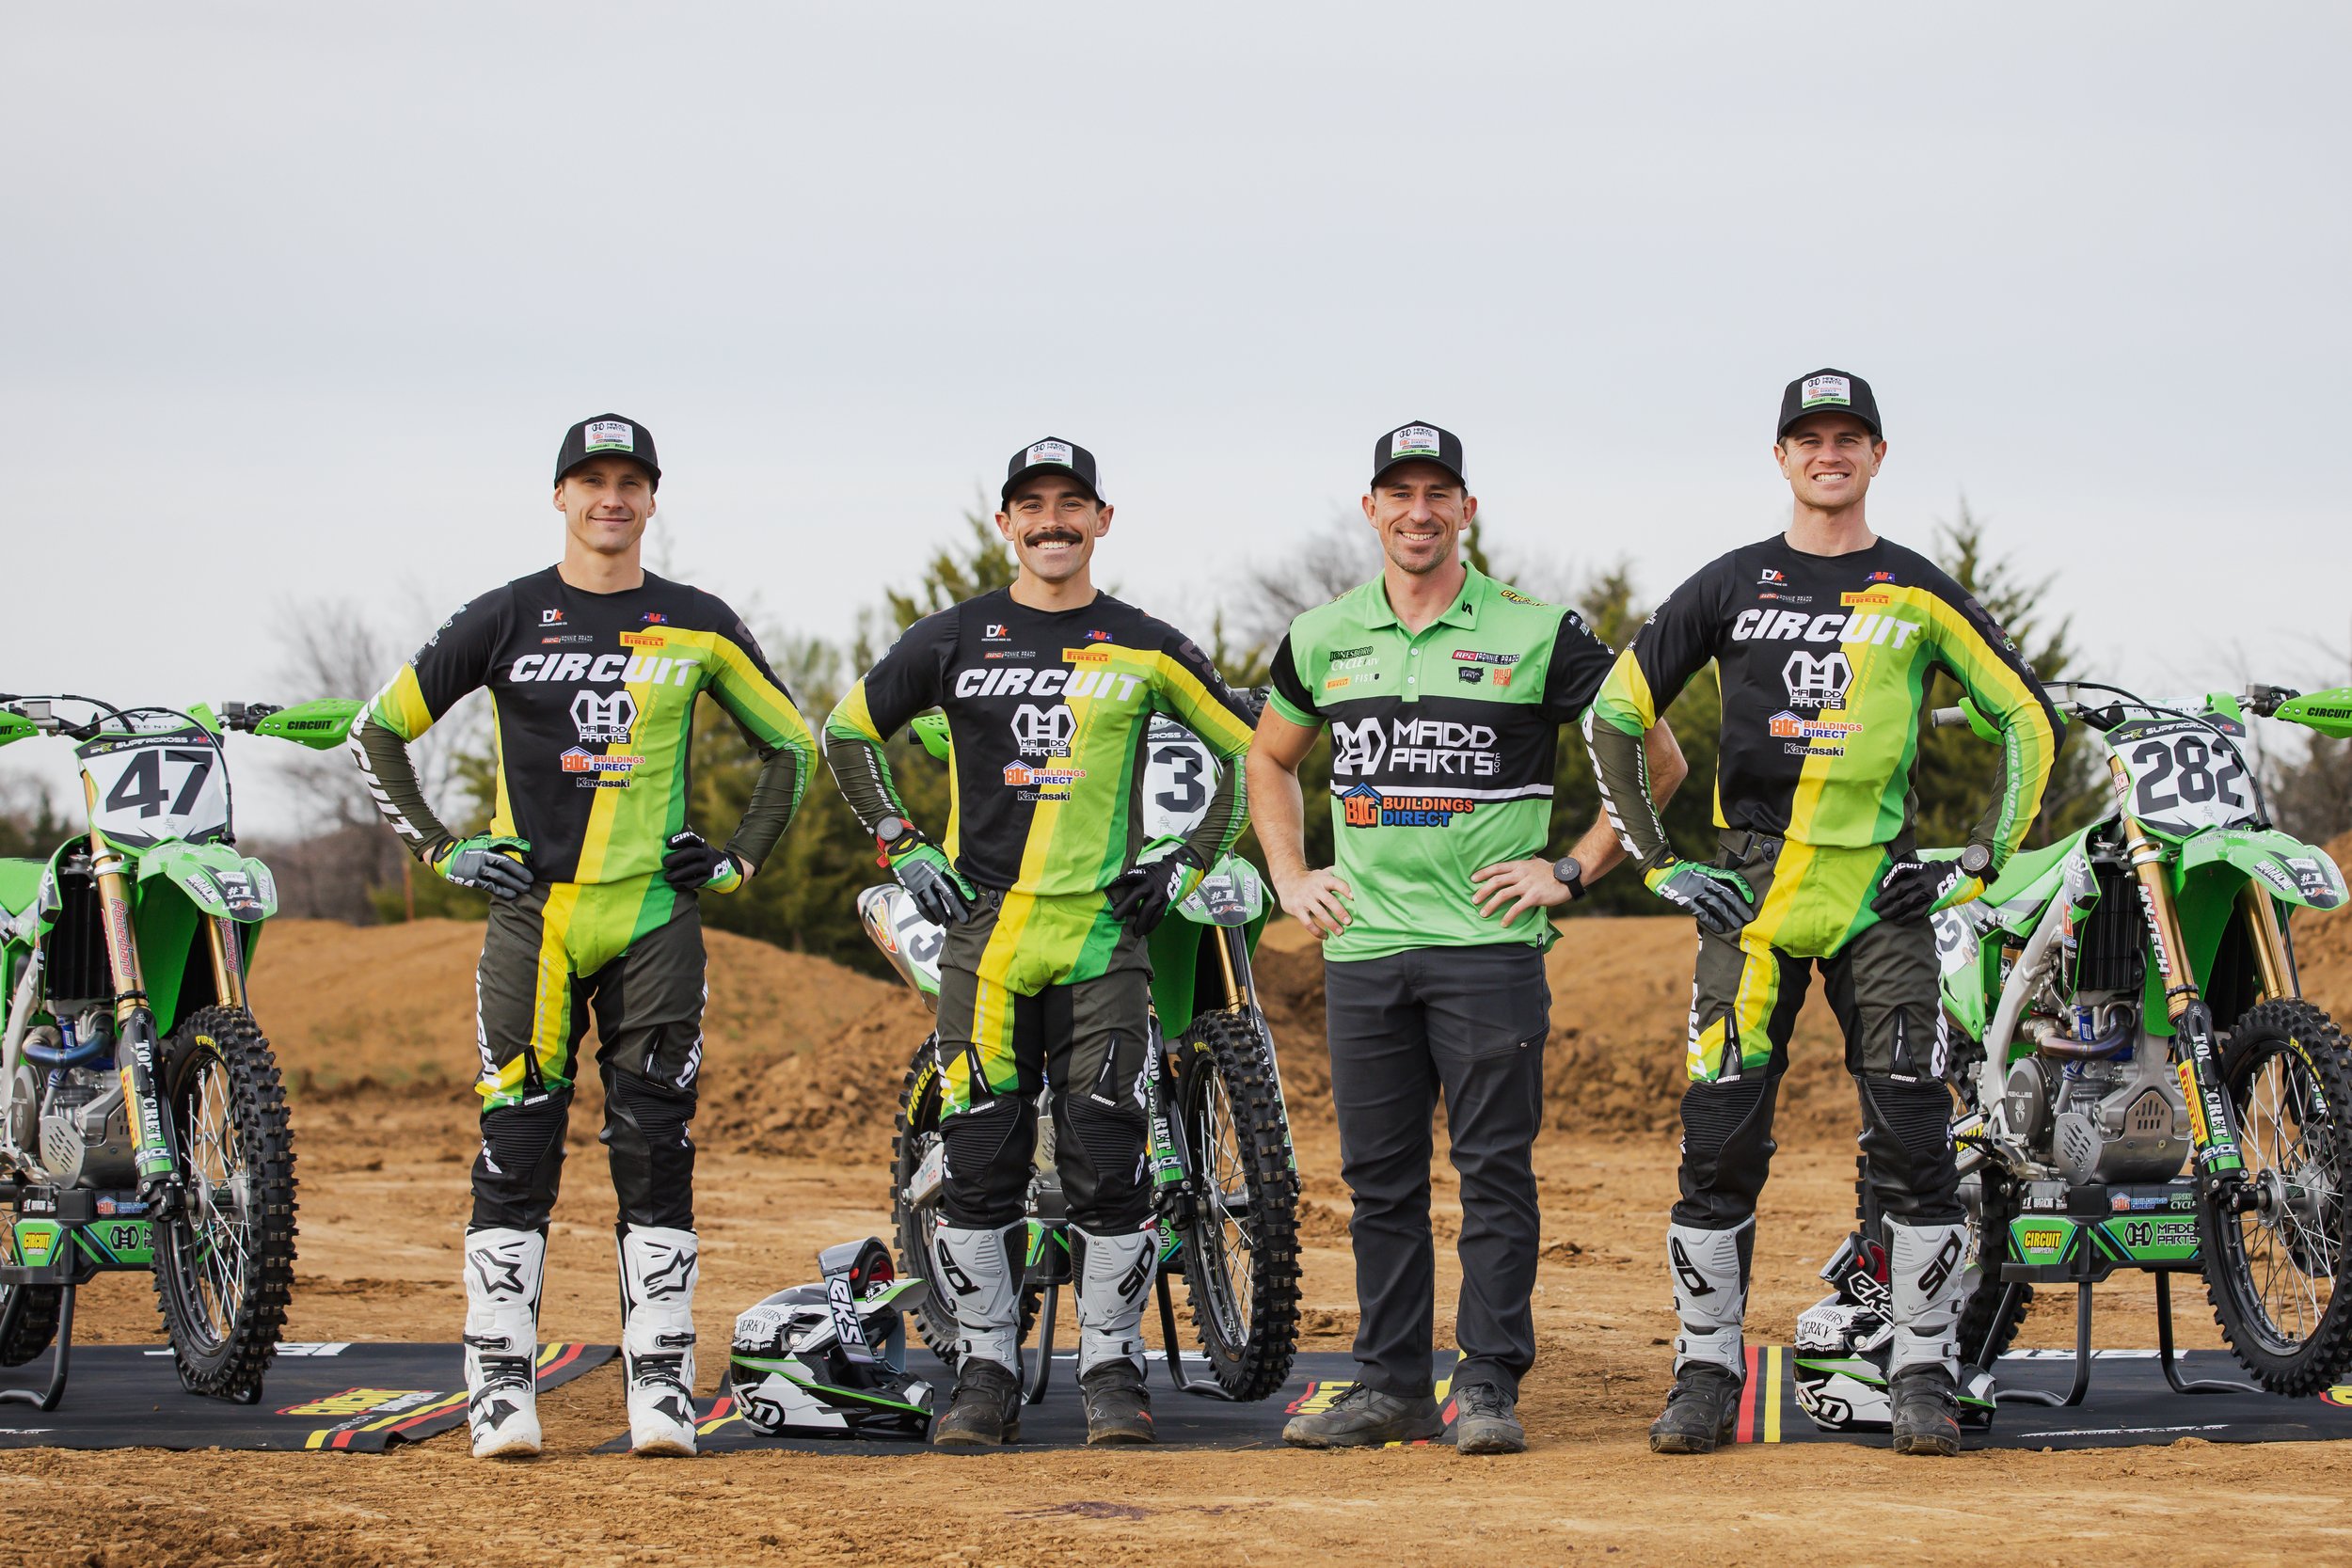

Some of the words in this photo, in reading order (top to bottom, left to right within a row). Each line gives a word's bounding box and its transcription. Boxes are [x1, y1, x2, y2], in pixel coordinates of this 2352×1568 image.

[1864, 571, 1896, 582] AMA
[1845, 594, 1889, 604] PIRELLI
[639, 612, 668, 624] AMA
[1084, 629, 1113, 641] AMA
[1731, 609, 1921, 650] CIRCUIT
[625, 635, 664, 647] PIRELLI
[1067, 651, 1108, 661] PIRELLI
[509, 653, 701, 687] CIRCUIT
[955, 668, 1146, 701] CIRCUIT
[1789, 697, 1841, 709] PARTS
[286, 720, 333, 731] CIRCUIT
[1393, 717, 1498, 748] MADD
[1804, 721, 1863, 731] BUILDINGS
[2146, 722, 2215, 736] SUPERCRO
[580, 734, 628, 743] PARTS
[1804, 729, 1848, 738] DIRECT
[116, 736, 188, 749] SUPERCROSS
[1785, 742, 1844, 756] Kawasaki
[1020, 747, 1067, 757] PARTS
[594, 755, 644, 764] BUILDINGS
[864, 746, 880, 781] RACING
[1389, 749, 1495, 775] PARTS
[1033, 768, 1086, 777] BUILDINGS
[2132, 736, 2245, 816] 282
[105, 749, 214, 819] 47
[577, 777, 630, 787] Kawasaki
[1017, 791, 1071, 800] Kawasaki
[1344, 794, 1375, 826] BIG
[1383, 798, 1474, 812] BUILDINGS
[1382, 812, 1453, 826] DIRECT
[1883, 862, 1924, 888] CIRCUIT
[222, 899, 269, 911] LUXON
[1204, 906, 1252, 917] LUXON
[2137, 884, 2171, 974] MX-TECH
[111, 898, 138, 979] Powerband
[2192, 1033, 2213, 1061] TO
[1890, 1073, 1917, 1083] CIRCUIT
[524, 1094, 548, 1106] CIRCUIT
[906, 1061, 938, 1126] PIRELL
[1090, 1093, 1117, 1107] CIRCUIT
[969, 1101, 995, 1114] CIRCUIT
[2178, 1066, 2203, 1139] PIRELLI
[2200, 1144, 2238, 1162] DEVOL
[24, 1232, 51, 1249] CIRCUIT
[2025, 1230, 2061, 1248] CIRCUIT
[739, 1319, 771, 1335] JERKY
[1802, 1322, 1834, 1338] JERKY
